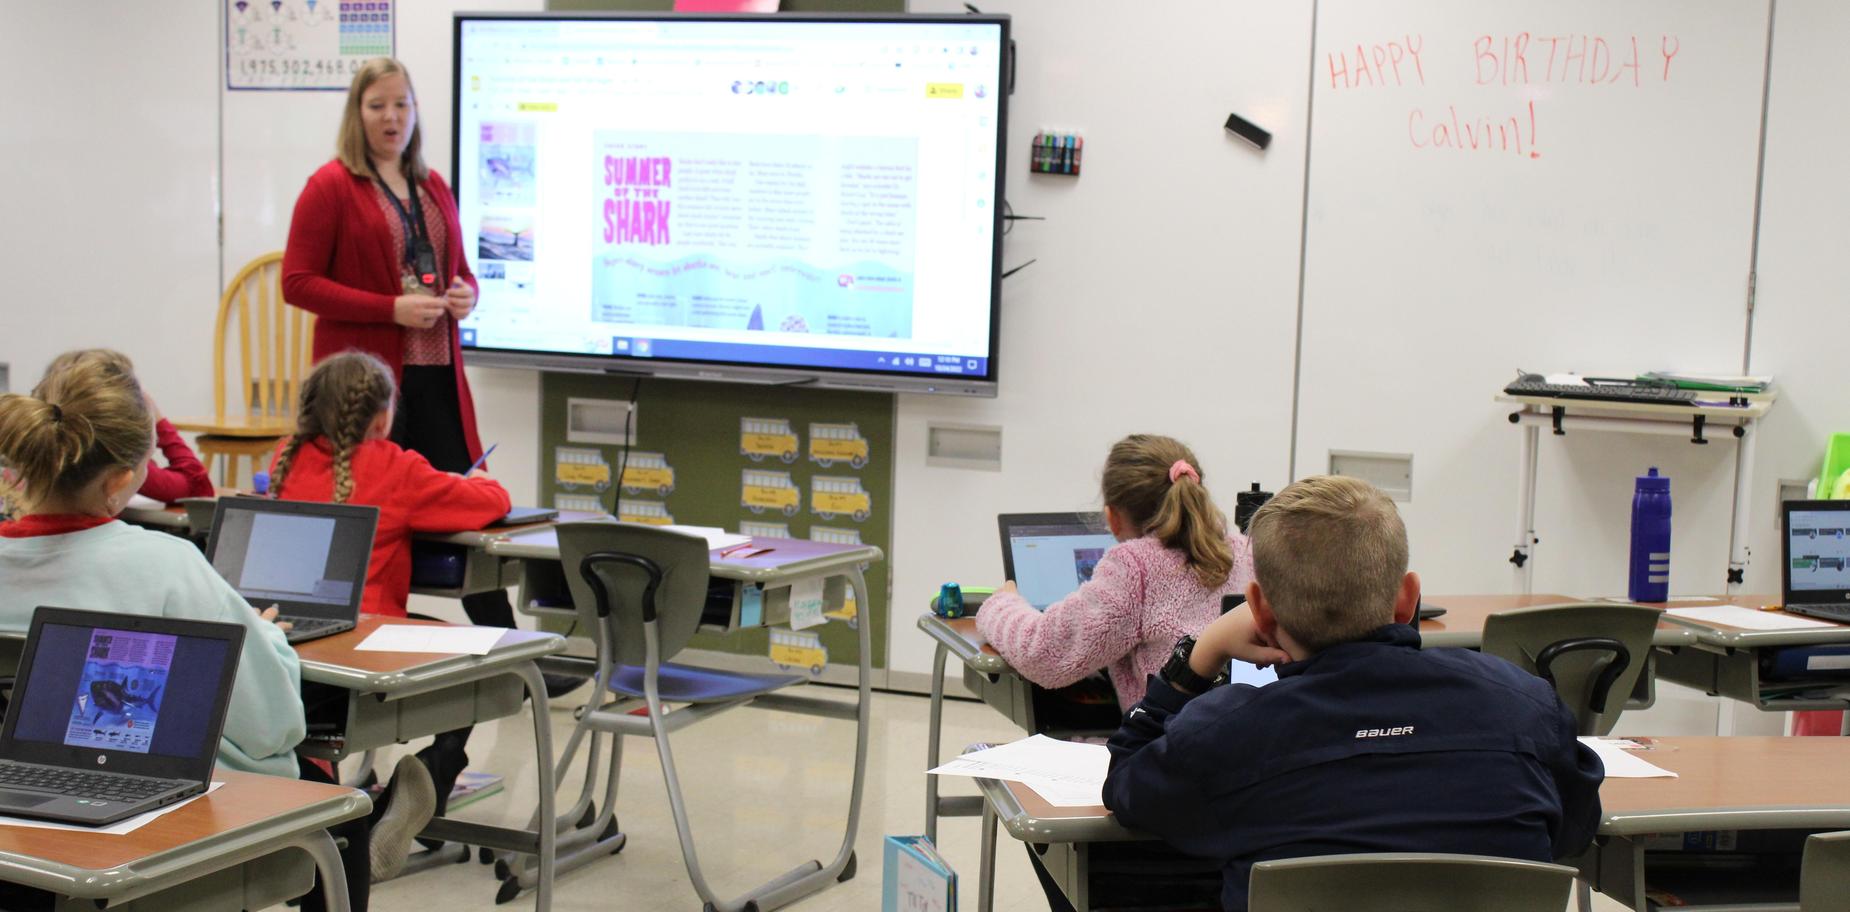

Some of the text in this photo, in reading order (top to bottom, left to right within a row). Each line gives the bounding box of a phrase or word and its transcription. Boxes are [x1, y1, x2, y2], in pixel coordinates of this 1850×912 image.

[1328, 31, 1680, 89] HAPPY BIRTHDAY
[1408, 100, 1541, 159] Calvin!
[603, 154, 672, 188] SUMMER
[614, 187, 659, 198] OF THE
[603, 197, 671, 246] SHARK
